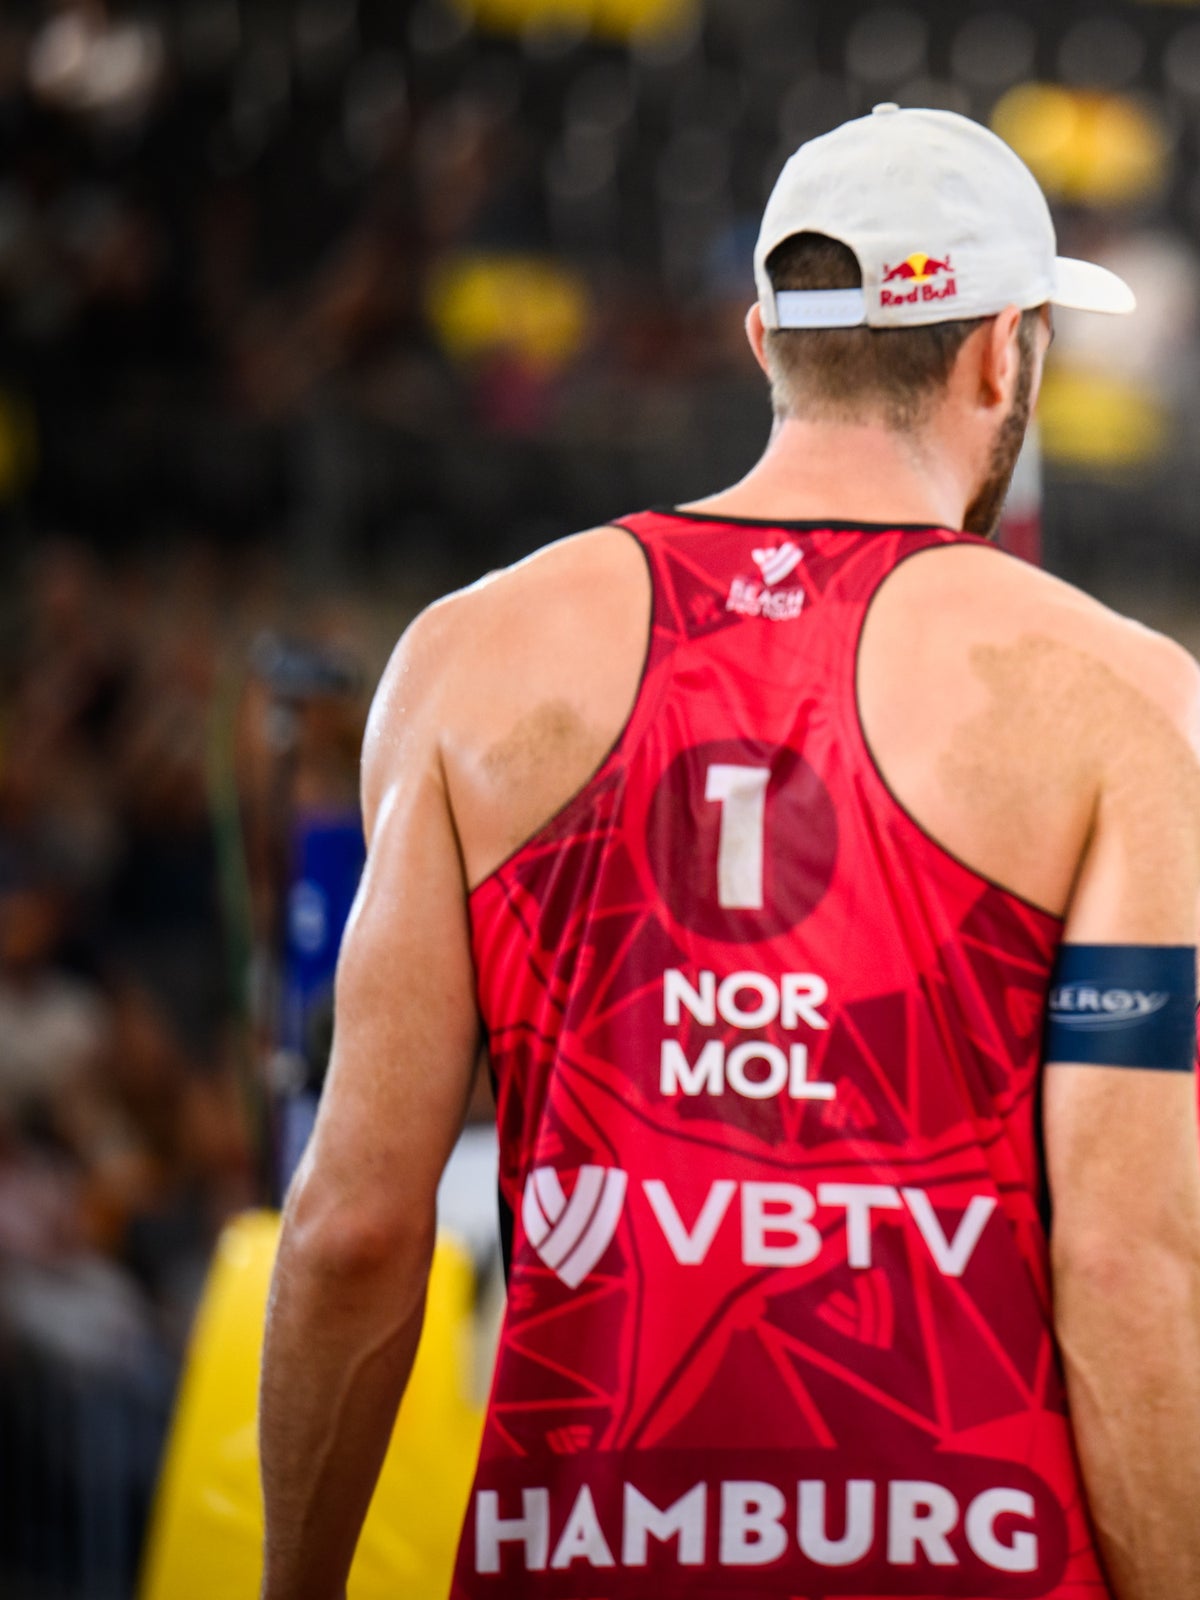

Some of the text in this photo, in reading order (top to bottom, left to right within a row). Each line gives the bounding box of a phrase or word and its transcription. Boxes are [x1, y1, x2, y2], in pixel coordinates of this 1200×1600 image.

[880, 278, 956, 307] Red Bull
[704, 764, 770, 910] 1
[663, 969, 829, 1029] NOR
[660, 1039, 836, 1099] MOL
[642, 1180, 998, 1276] VBTV
[475, 1480, 1038, 1573] HAMBURG
